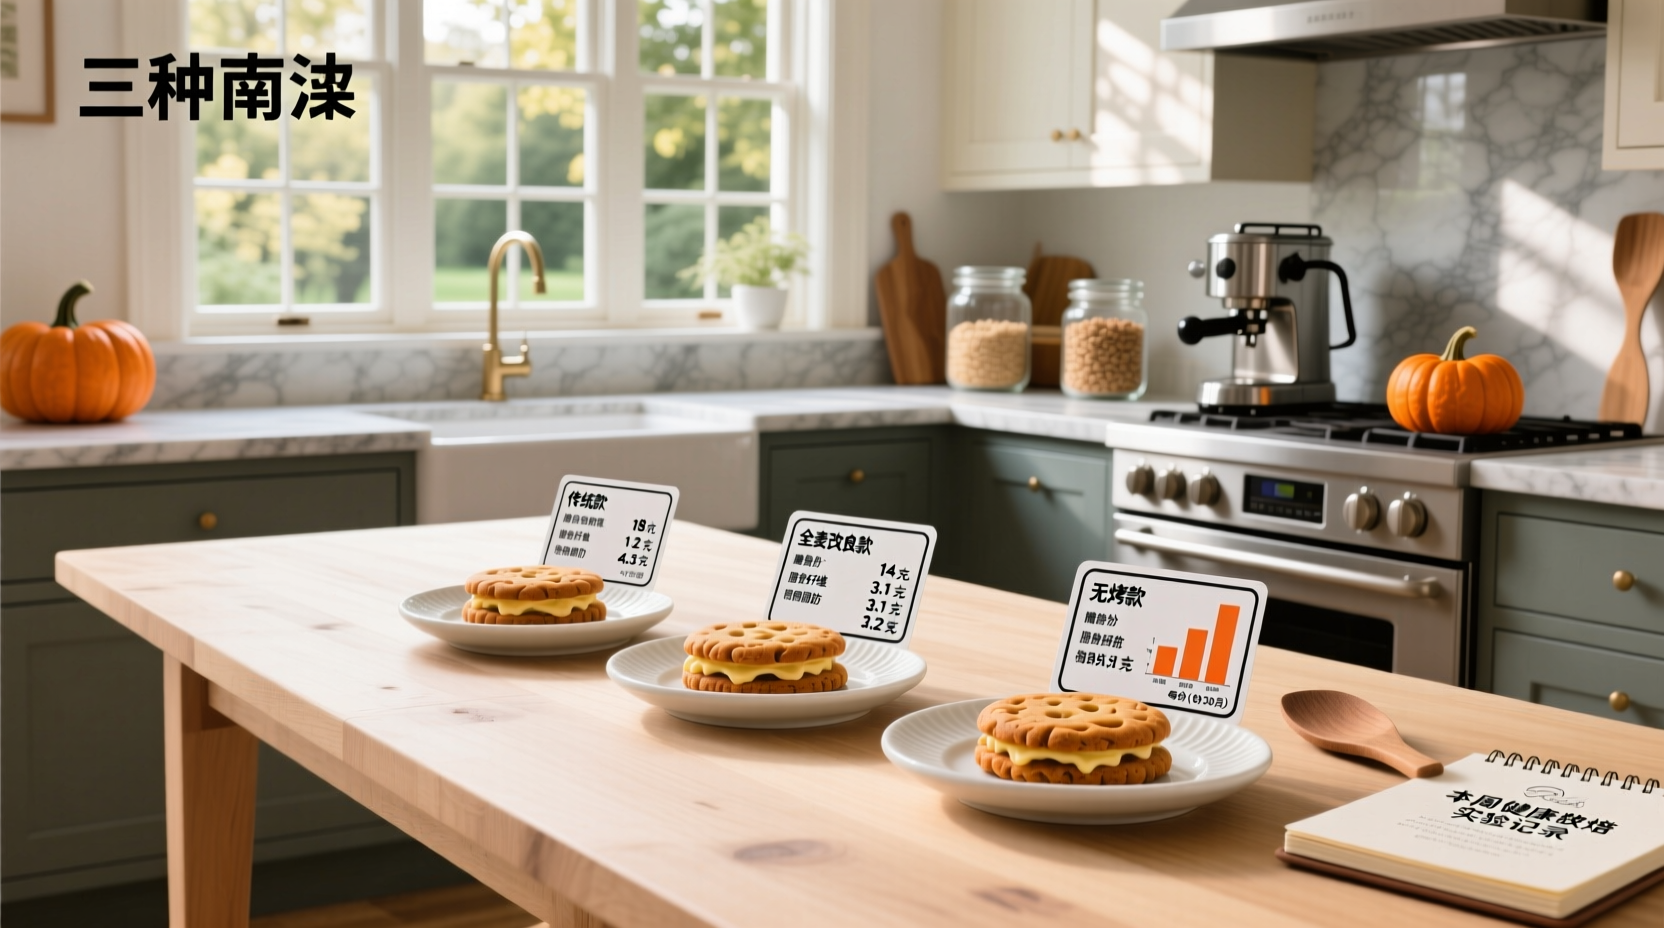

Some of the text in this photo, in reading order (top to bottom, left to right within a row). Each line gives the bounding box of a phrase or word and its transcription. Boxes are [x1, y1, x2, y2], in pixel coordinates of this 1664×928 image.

[798, 528, 873, 555] 全麦改良款
[1089, 582, 1146, 608] 无烤款
